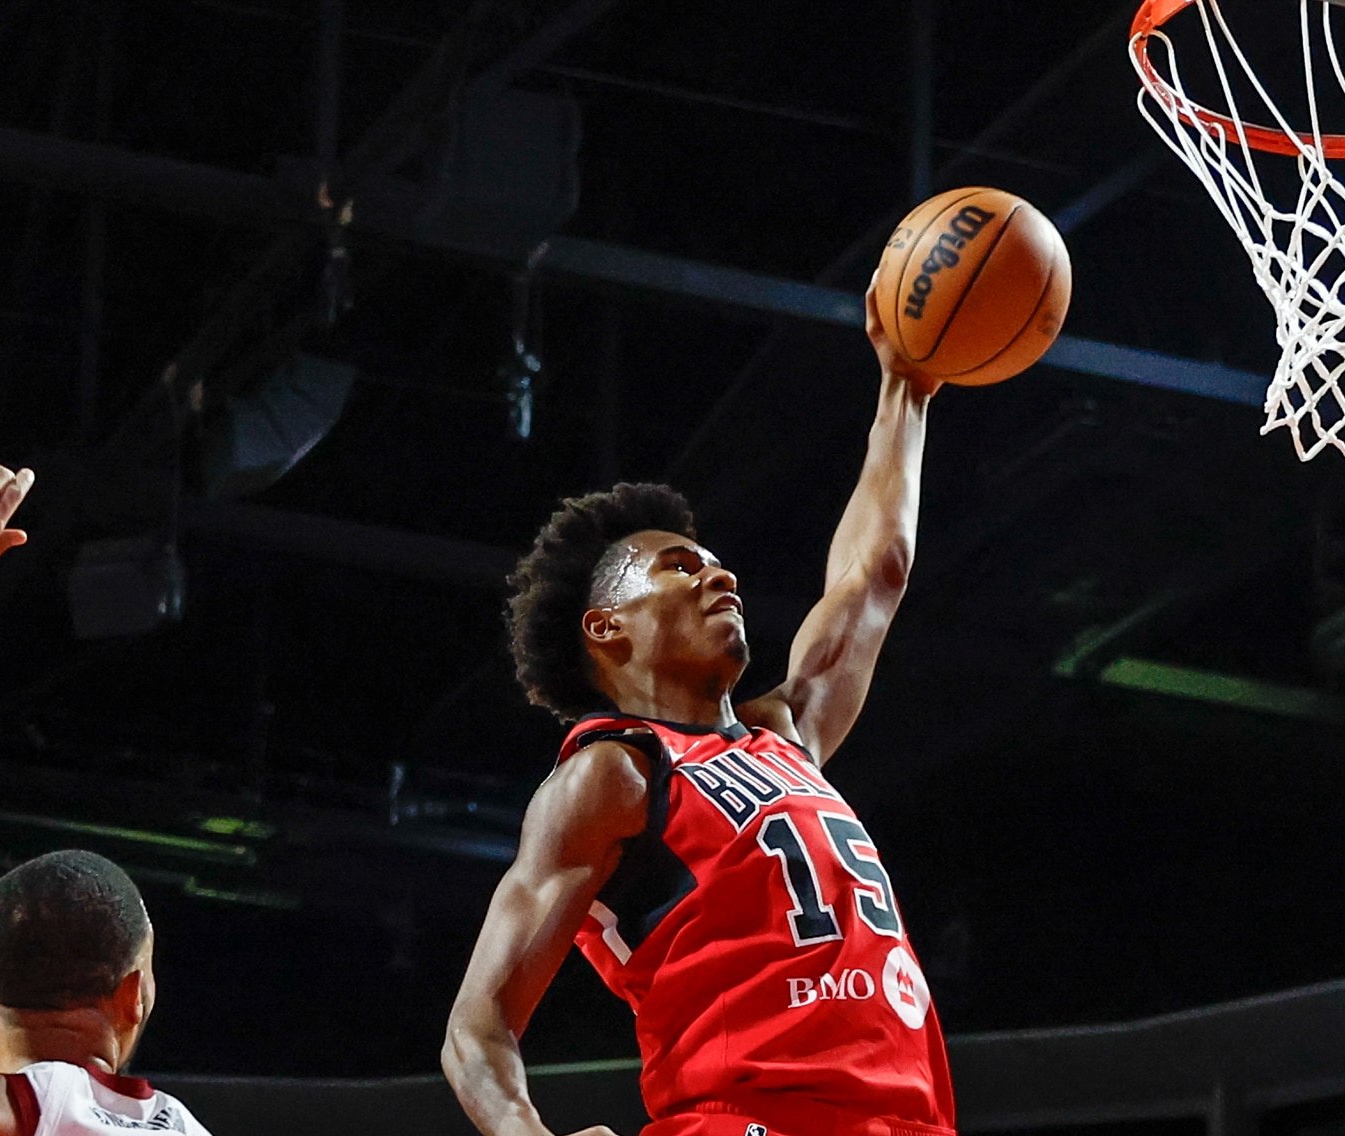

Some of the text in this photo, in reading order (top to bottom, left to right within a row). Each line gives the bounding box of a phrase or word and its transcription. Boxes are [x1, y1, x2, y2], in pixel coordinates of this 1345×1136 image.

[904, 204, 996, 320] Wilson
[674, 748, 842, 836] BULL
[756, 811, 903, 949] 15
[786, 968, 876, 1009] BMO
